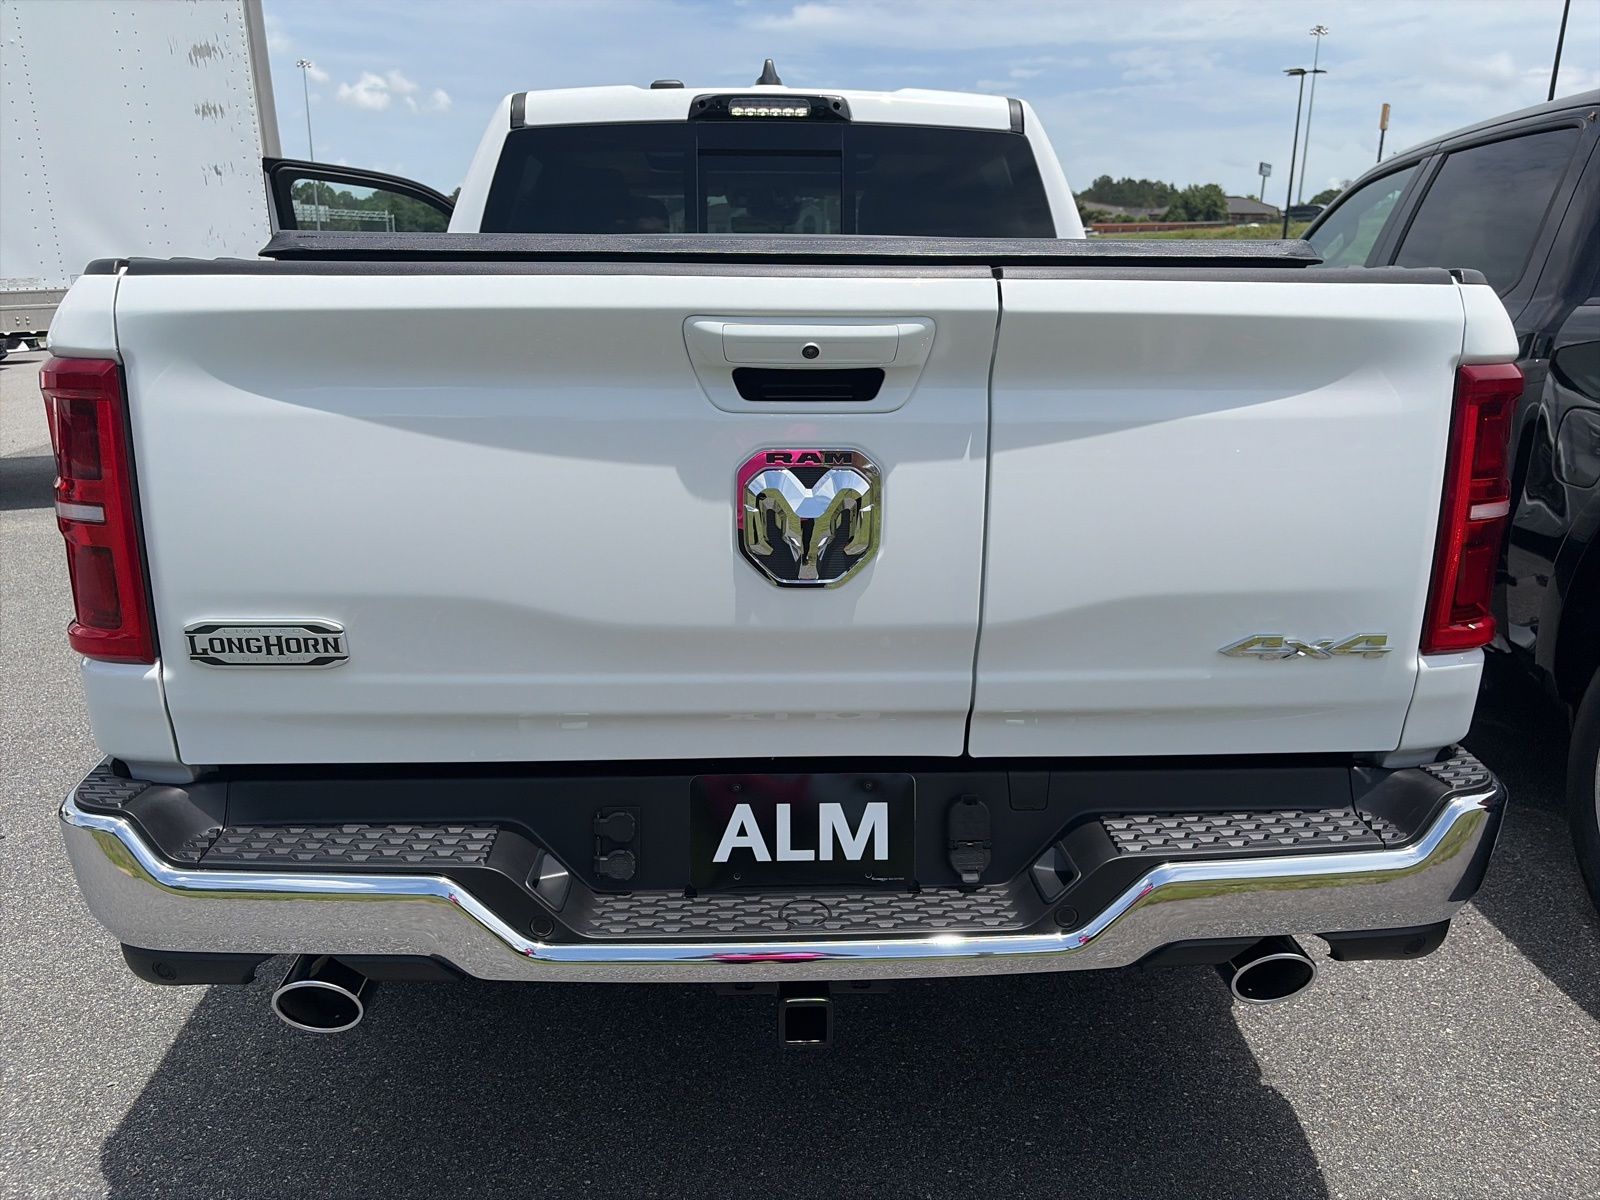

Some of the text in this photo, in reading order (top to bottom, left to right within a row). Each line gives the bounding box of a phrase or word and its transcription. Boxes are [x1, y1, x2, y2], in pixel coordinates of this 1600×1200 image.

[766, 452, 852, 464] RAM
[185, 635, 342, 656] LONGHORN
[712, 801, 889, 863] ALM
